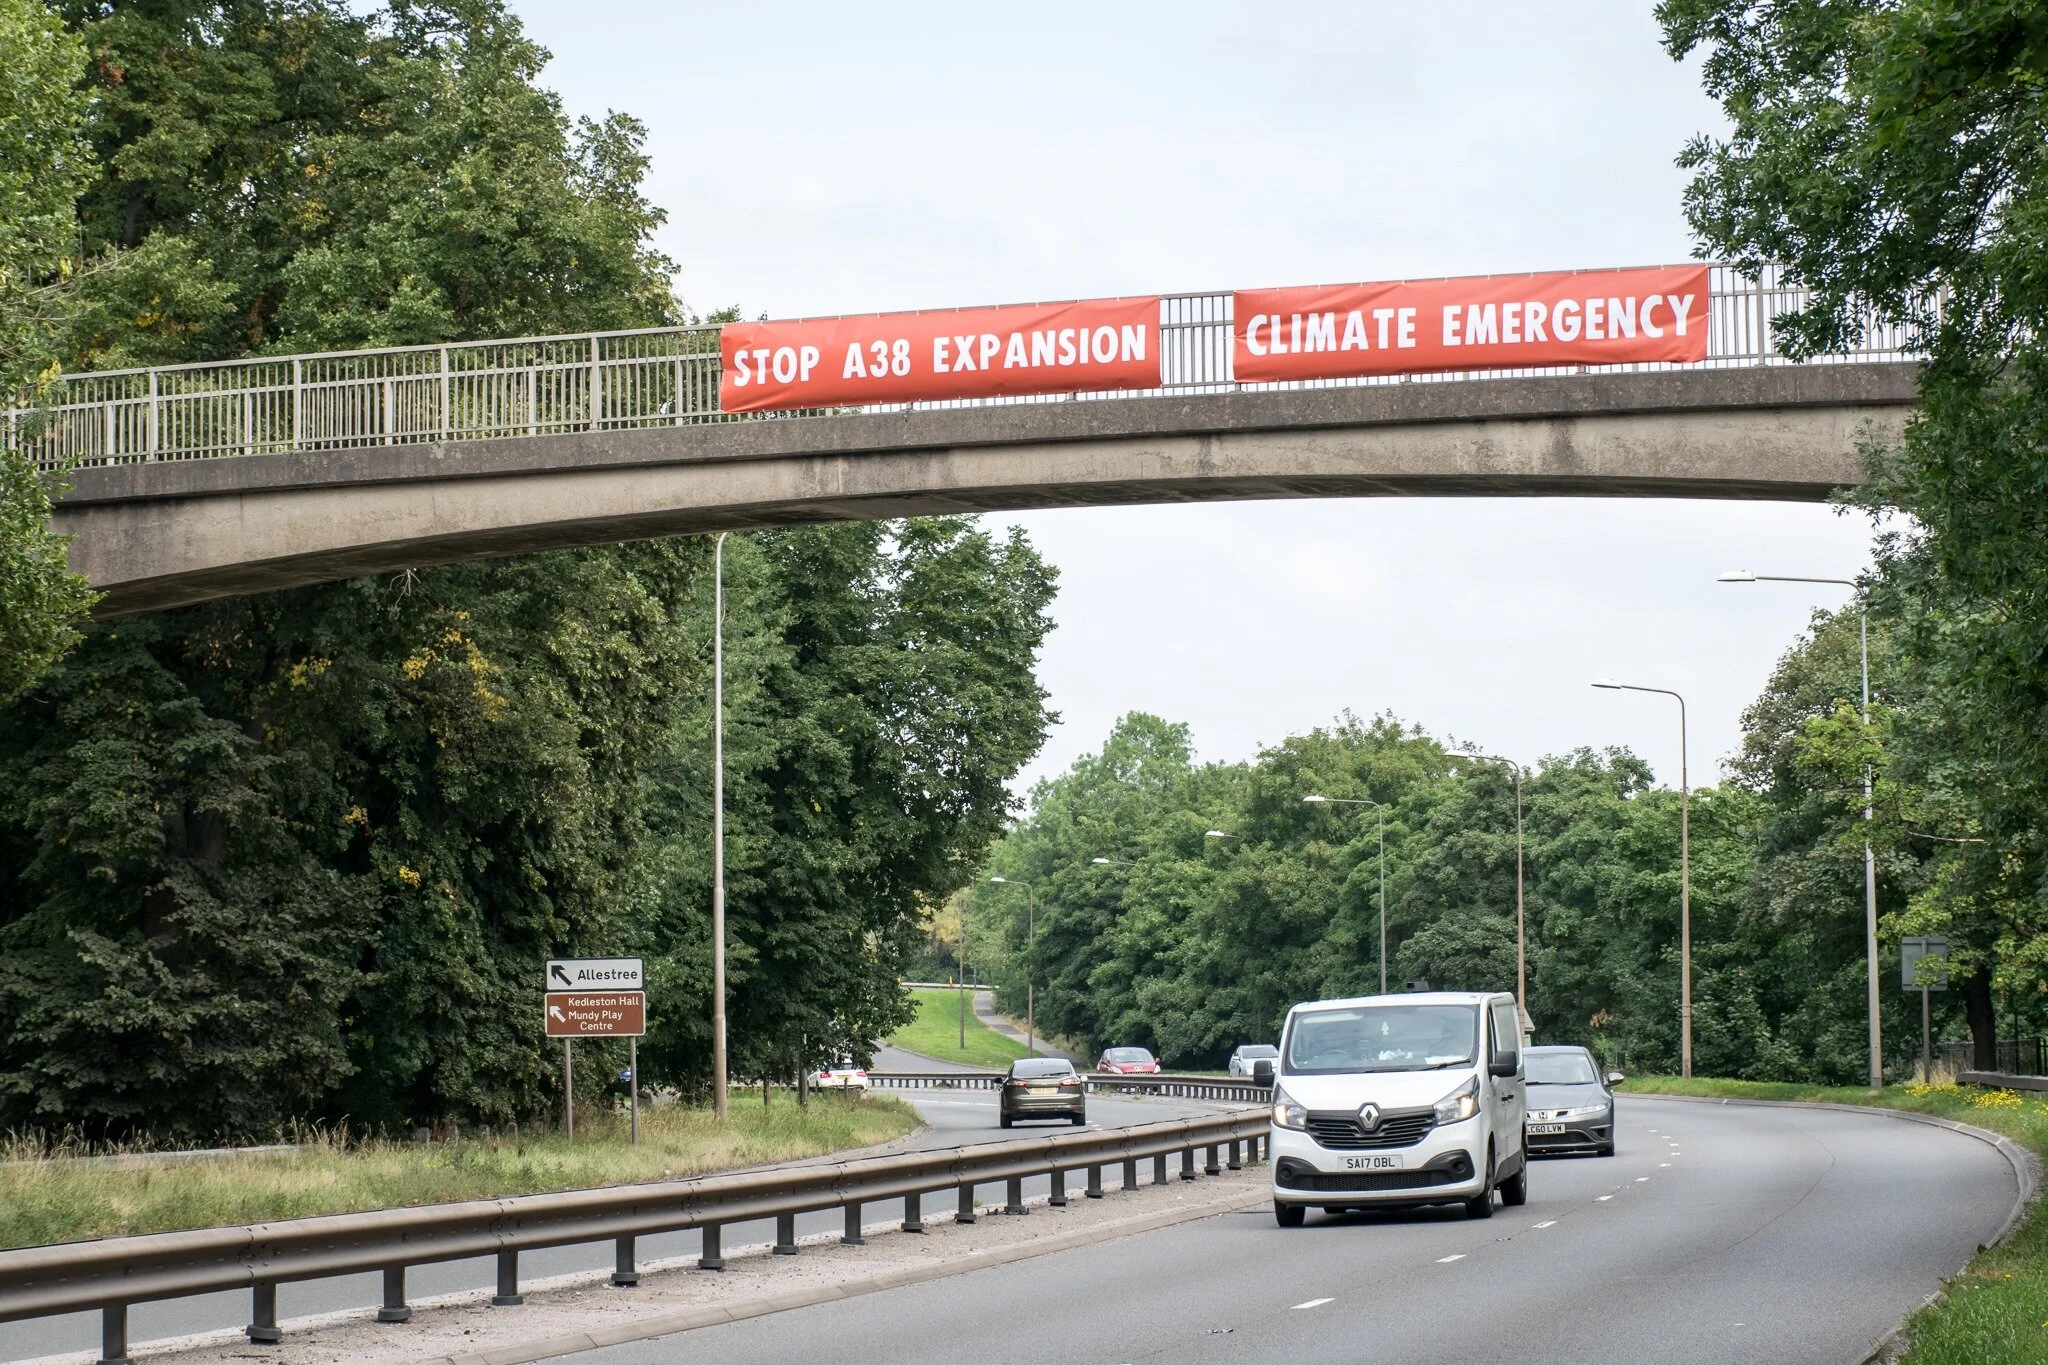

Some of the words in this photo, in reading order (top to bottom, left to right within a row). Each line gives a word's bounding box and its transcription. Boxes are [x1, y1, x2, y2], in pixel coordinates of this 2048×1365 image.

[1245, 306, 1417, 357] CLIMATE
[1442, 294, 1696, 347] EMERGENCY
[733, 345, 820, 387] STOP
[842, 338, 911, 379] A38
[932, 323, 1147, 374] EXPANSION
[577, 969, 638, 980] Allestree
[568, 997, 617, 1007] Kedleston
[619, 996, 639, 1006] Hall
[568, 1011, 600, 1021] Mundy
[602, 1010, 623, 1020] Play
[580, 1022, 613, 1031] Centre
[1346, 1158, 1371, 1169] SA17
[1373, 1157, 1396, 1168] OBL
